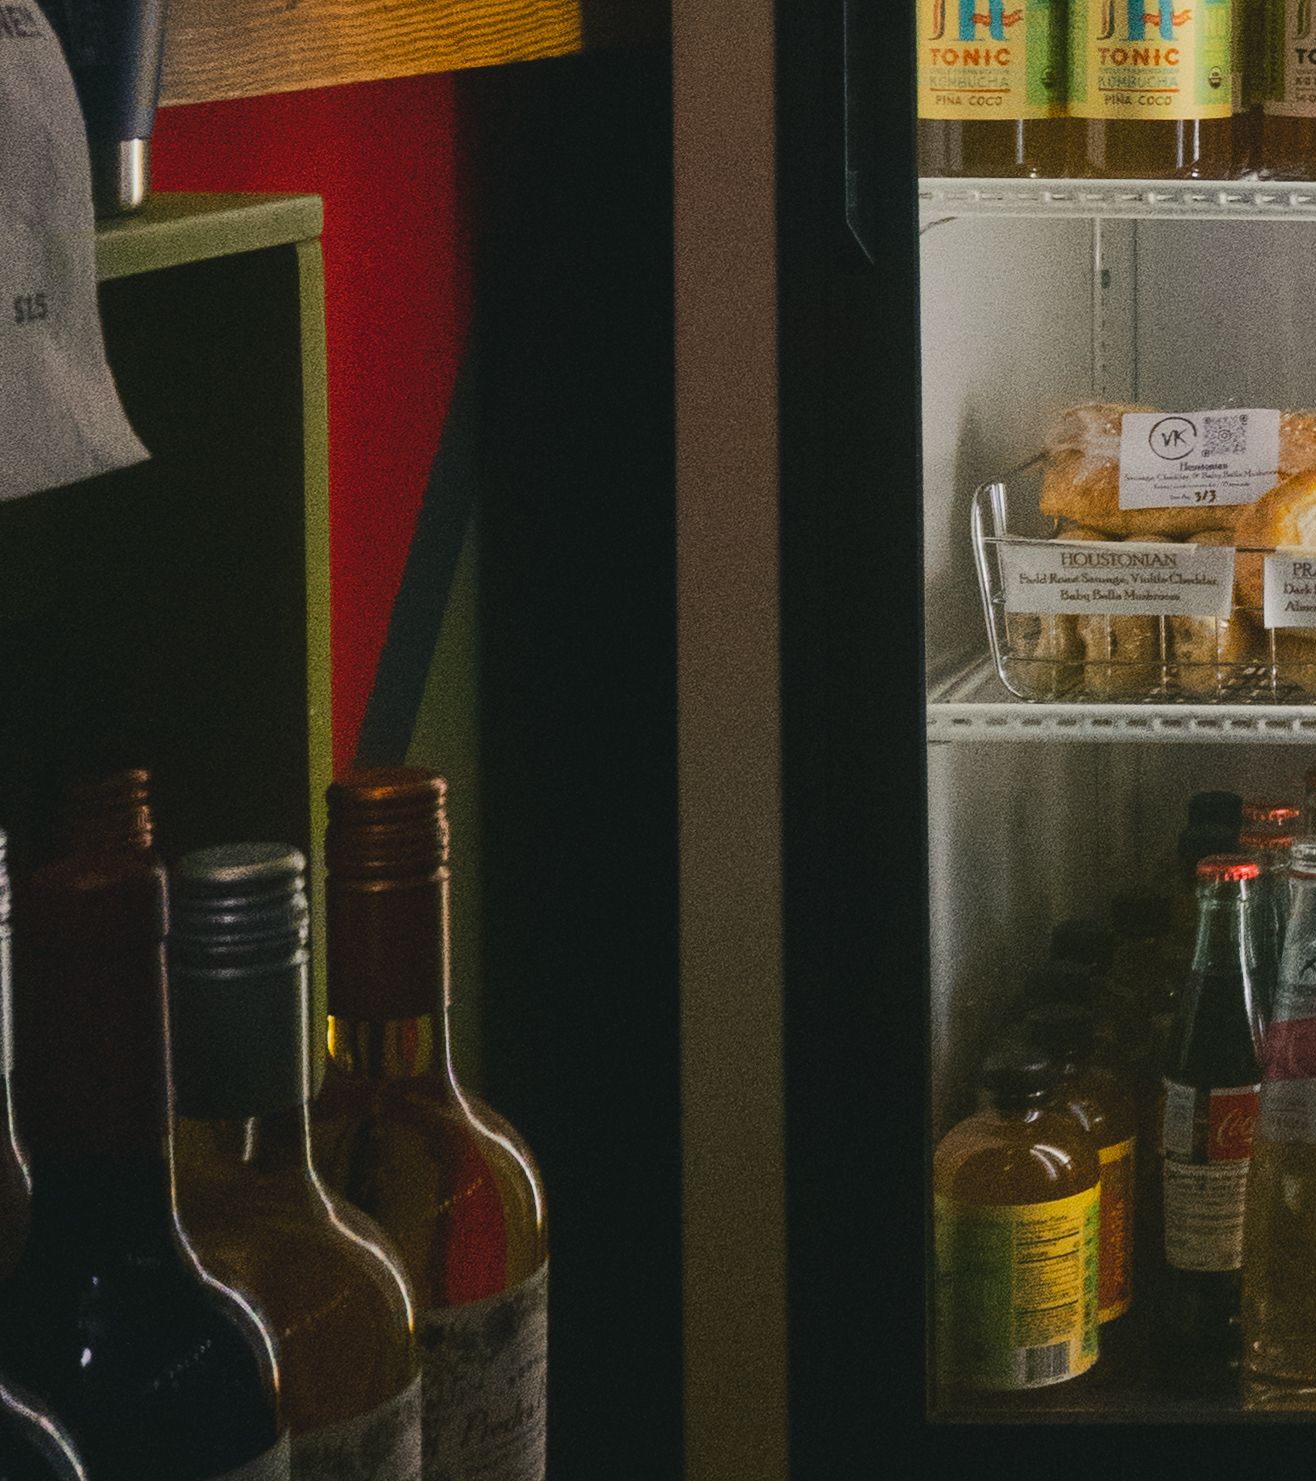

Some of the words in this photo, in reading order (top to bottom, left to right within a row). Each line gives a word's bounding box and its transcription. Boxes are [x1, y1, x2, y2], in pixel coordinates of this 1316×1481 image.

[928, 47, 1012, 67] TONIC
[1096, 47, 1180, 67] TONIC
[1097, 75, 1180, 89] KOMBUCHA
[968, 93, 1003, 107] COCO
[1137, 93, 1172, 107] COCO
[1060, 551, 1178, 568] HOUSTONIAN
